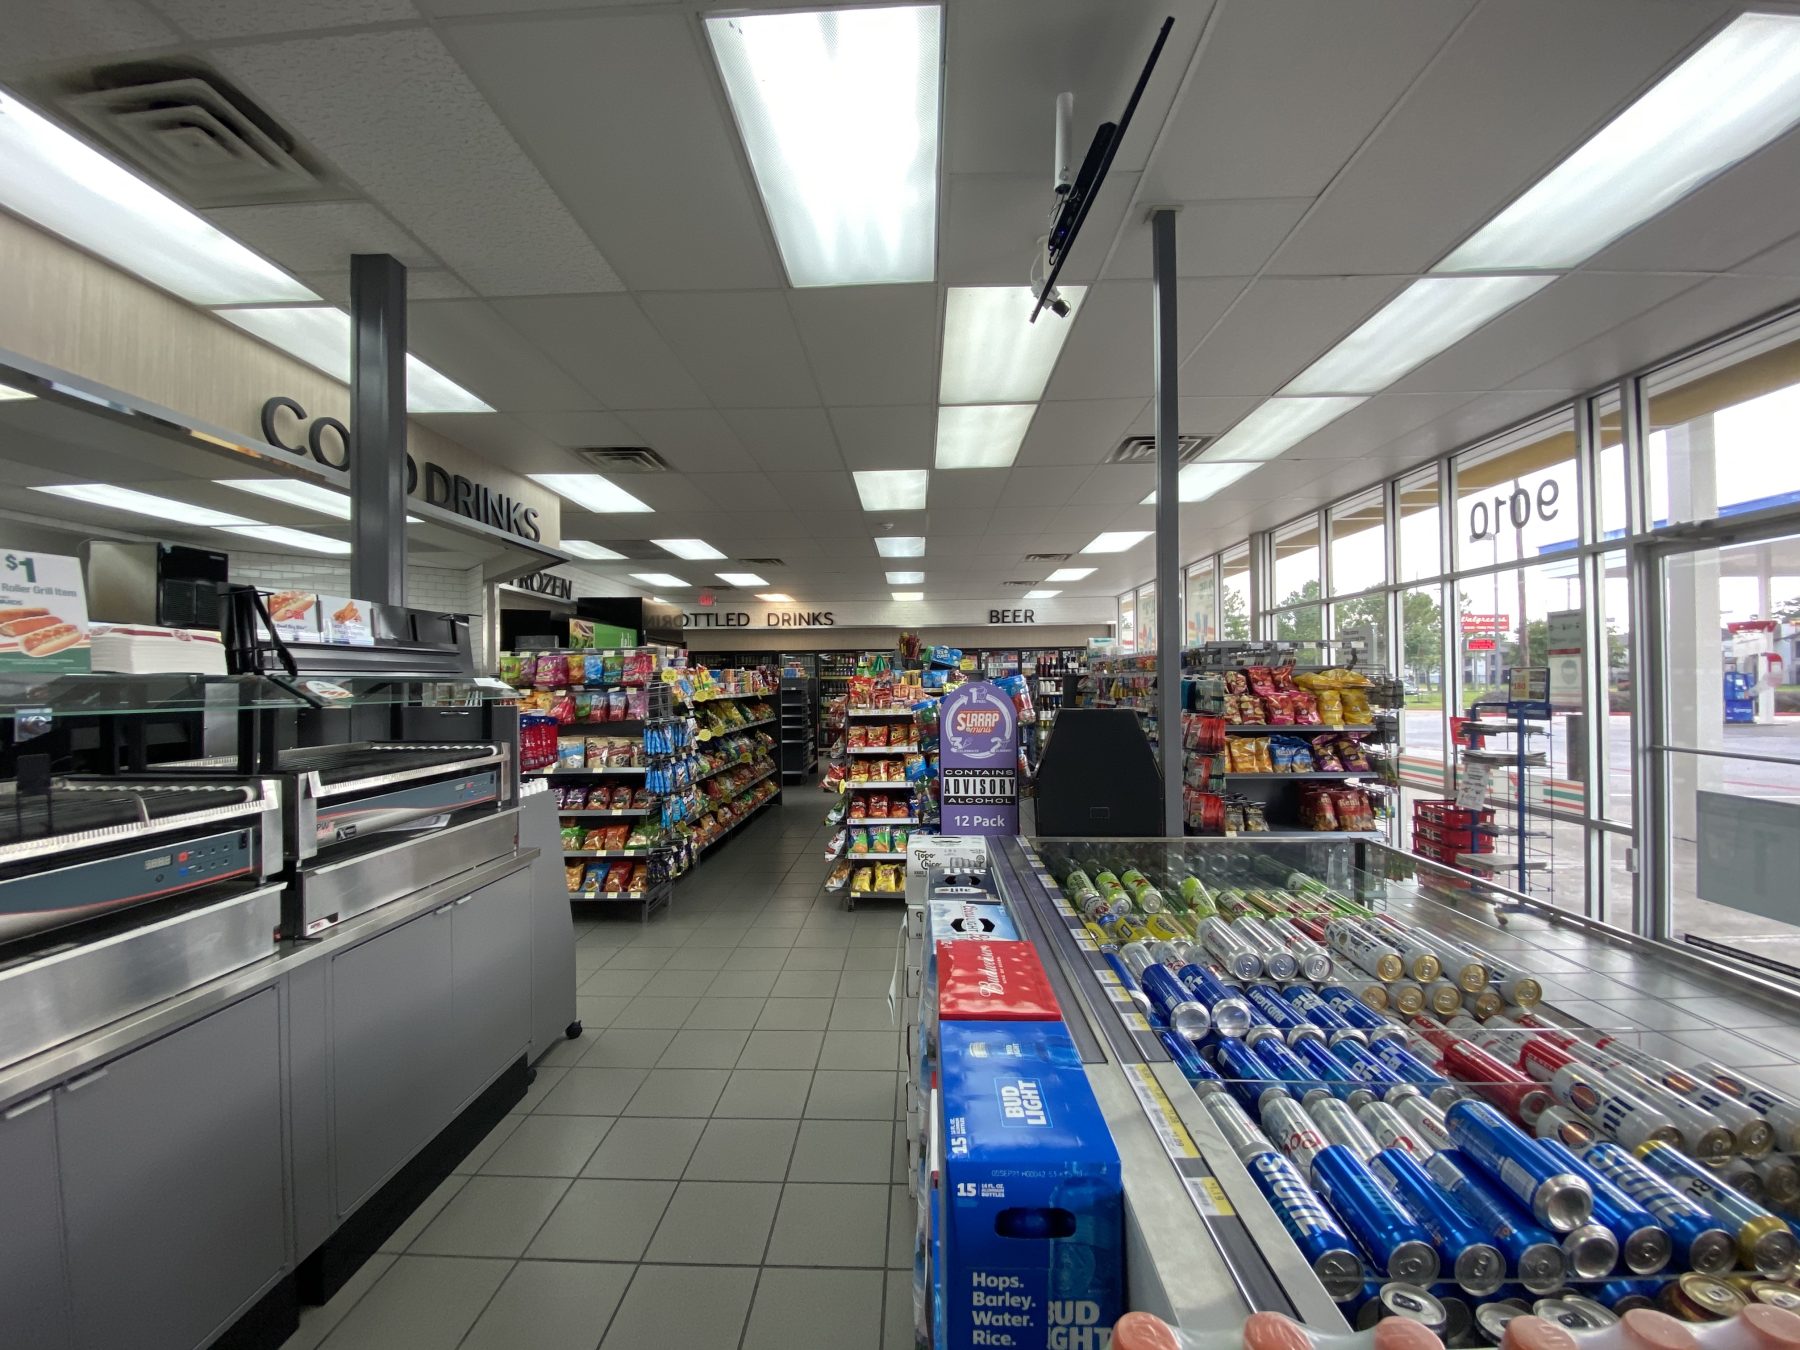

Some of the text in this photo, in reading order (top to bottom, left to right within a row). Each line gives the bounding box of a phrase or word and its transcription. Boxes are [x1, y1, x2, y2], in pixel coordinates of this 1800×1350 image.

[425, 462, 541, 543] DRINKS
[5, 554, 37, 583] $1
[33, 586, 53, 595] Grill
[55, 588, 77, 597] Item
[767, 612, 834, 627] DRINKS
[989, 609, 1035, 624] BEER
[944, 779, 1015, 795] ADVISORY
[954, 814, 1005, 827] 12 Pack
[914, 850, 936, 860] Topo
[921, 859, 942, 870] Chico
[978, 945, 1004, 997] Budweiser
[1001, 1086, 1025, 1118] BUD
[1018, 1080, 1047, 1125] LIGHT
[951, 1137, 968, 1155] 15
[957, 1183, 977, 1197] 15
[972, 1272, 1024, 1290] Hops.
[972, 1291, 1036, 1310] Barley.
[972, 1311, 1034, 1327] Water.
[972, 1330, 1016, 1346] Rice.
